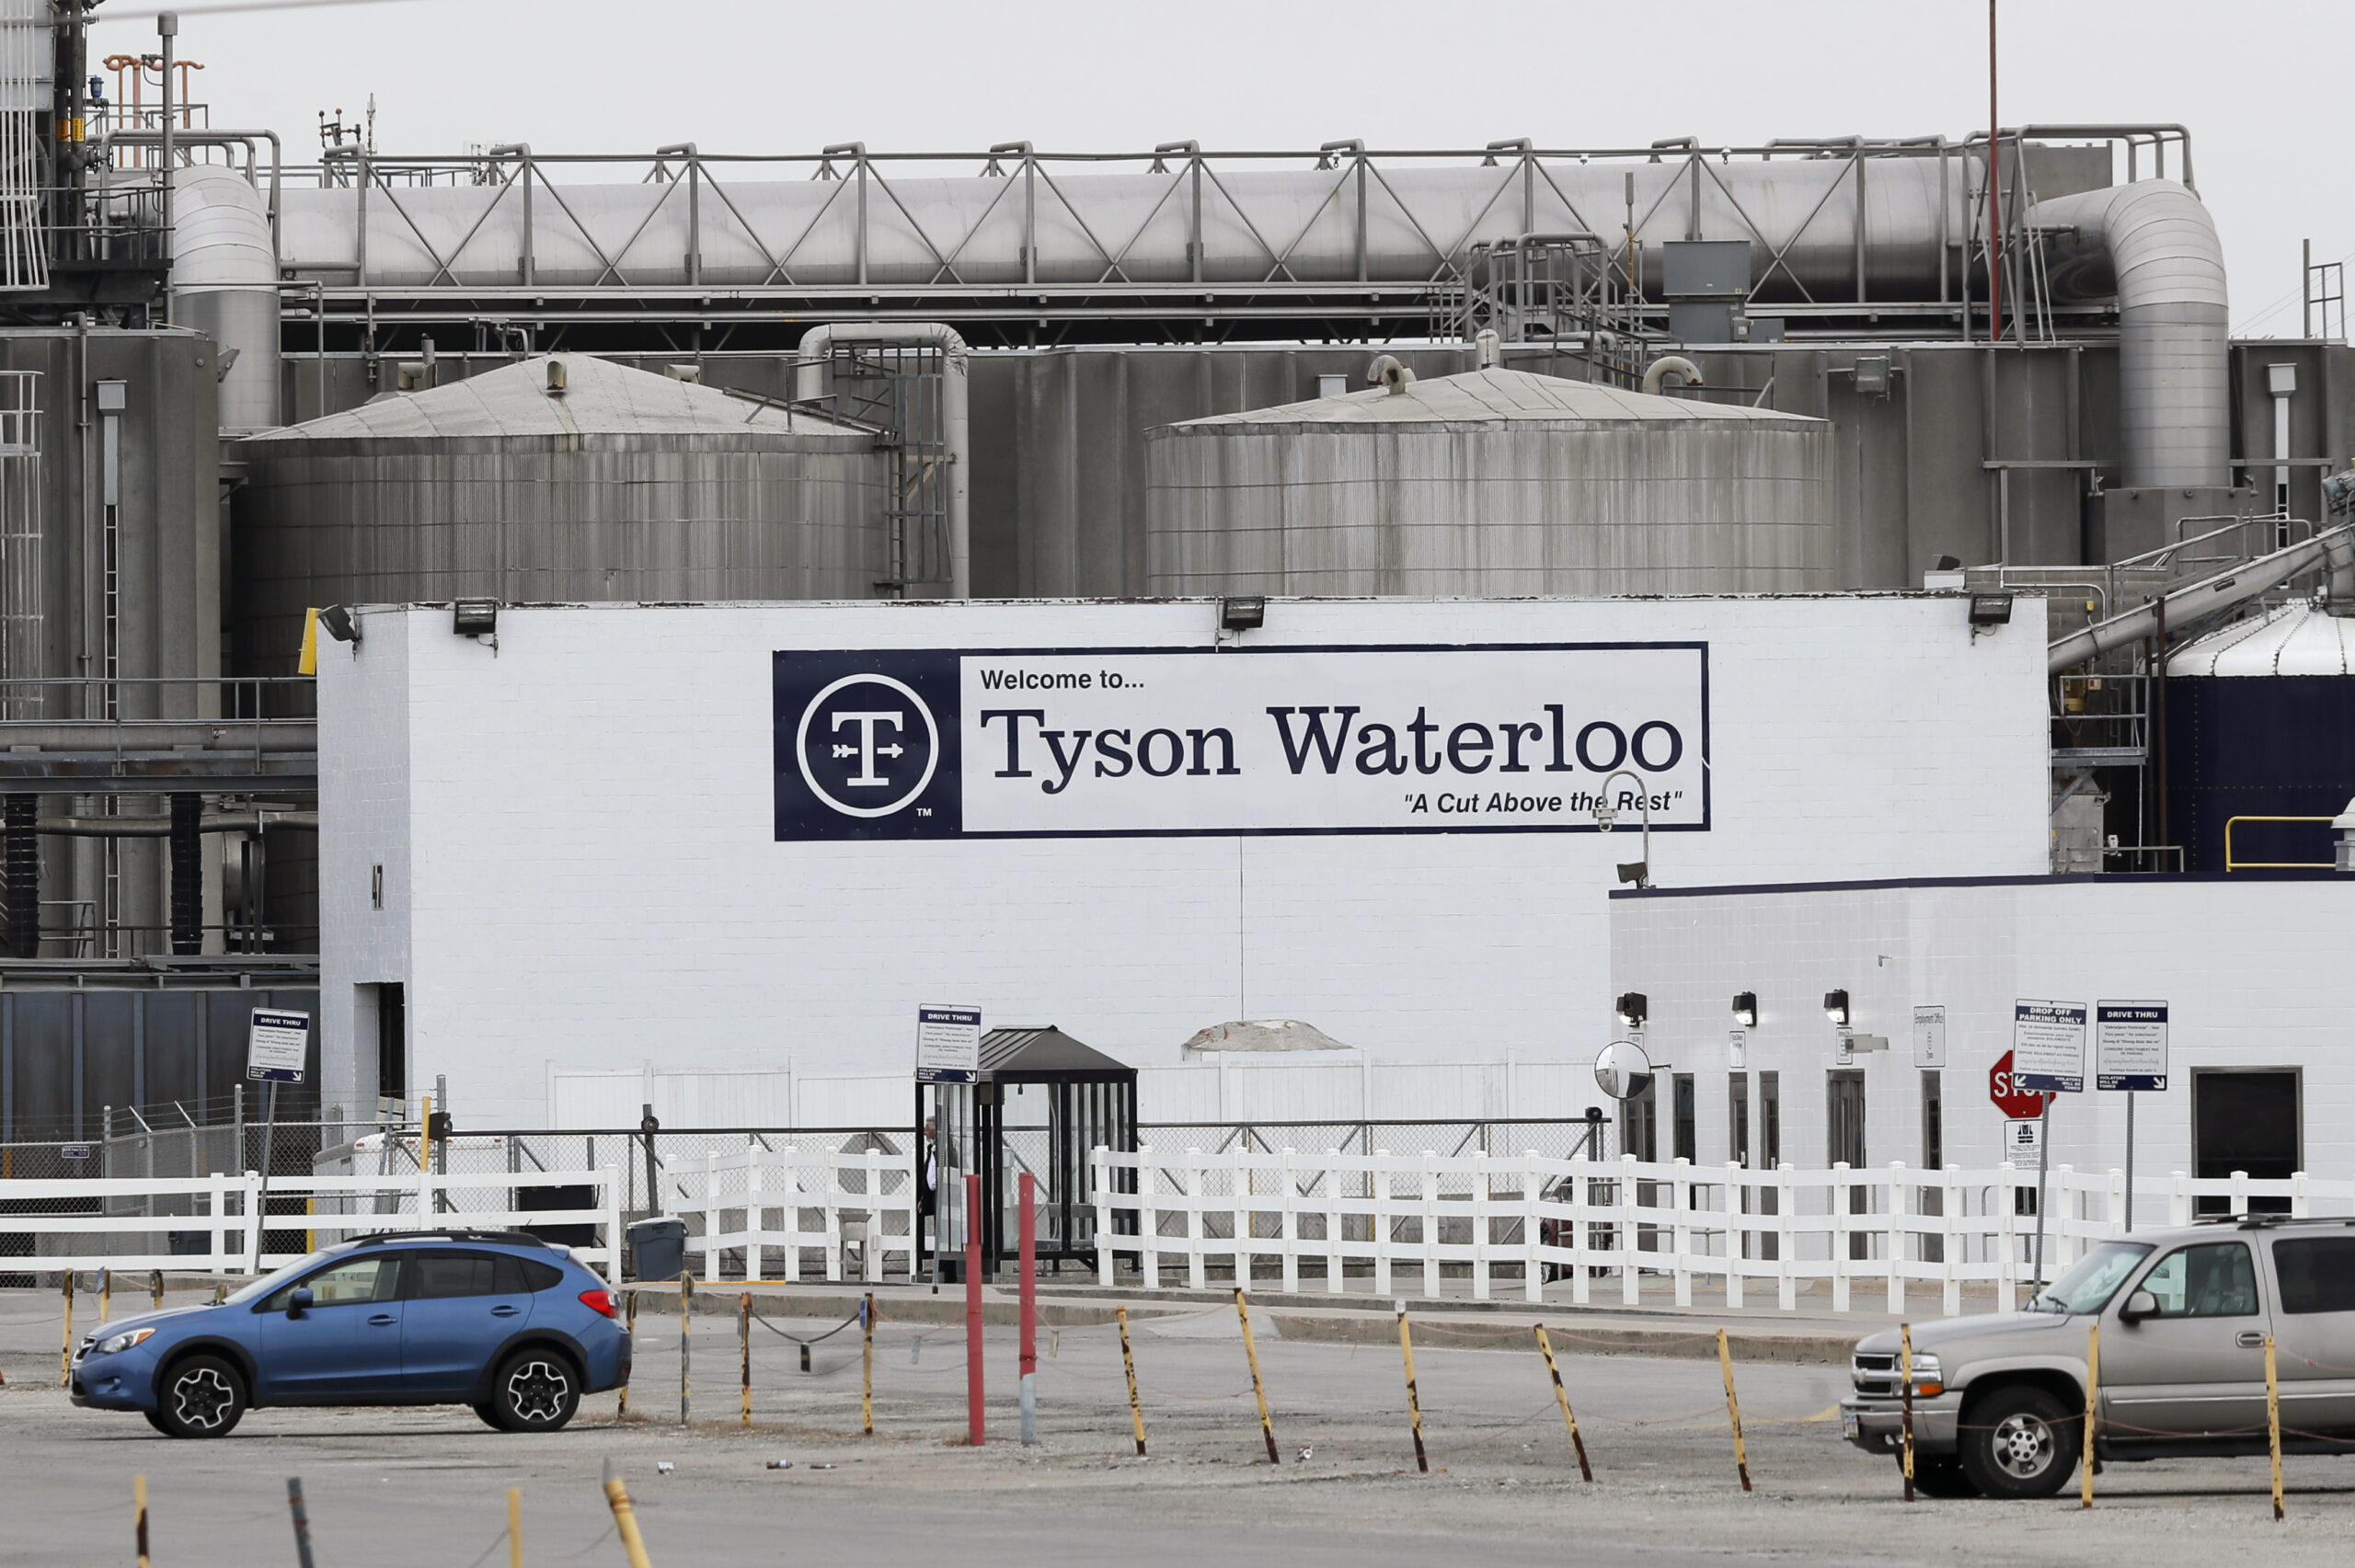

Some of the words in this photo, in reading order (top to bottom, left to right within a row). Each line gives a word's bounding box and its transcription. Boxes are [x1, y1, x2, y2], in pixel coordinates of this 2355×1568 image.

[980, 670, 1092, 690] Welcome
[1099, 670, 1144, 690] to...
[981, 709, 1241, 795] Tyson
[1266, 704, 1683, 776] Waterloo
[1405, 794, 1429, 813] "A
[1437, 793, 1480, 813] Cut
[1486, 792, 1562, 813] Above
[1570, 791, 1608, 811] the
[1617, 791, 1683, 811] Rest"
[2019, 1014, 2056, 1023] PARKING
